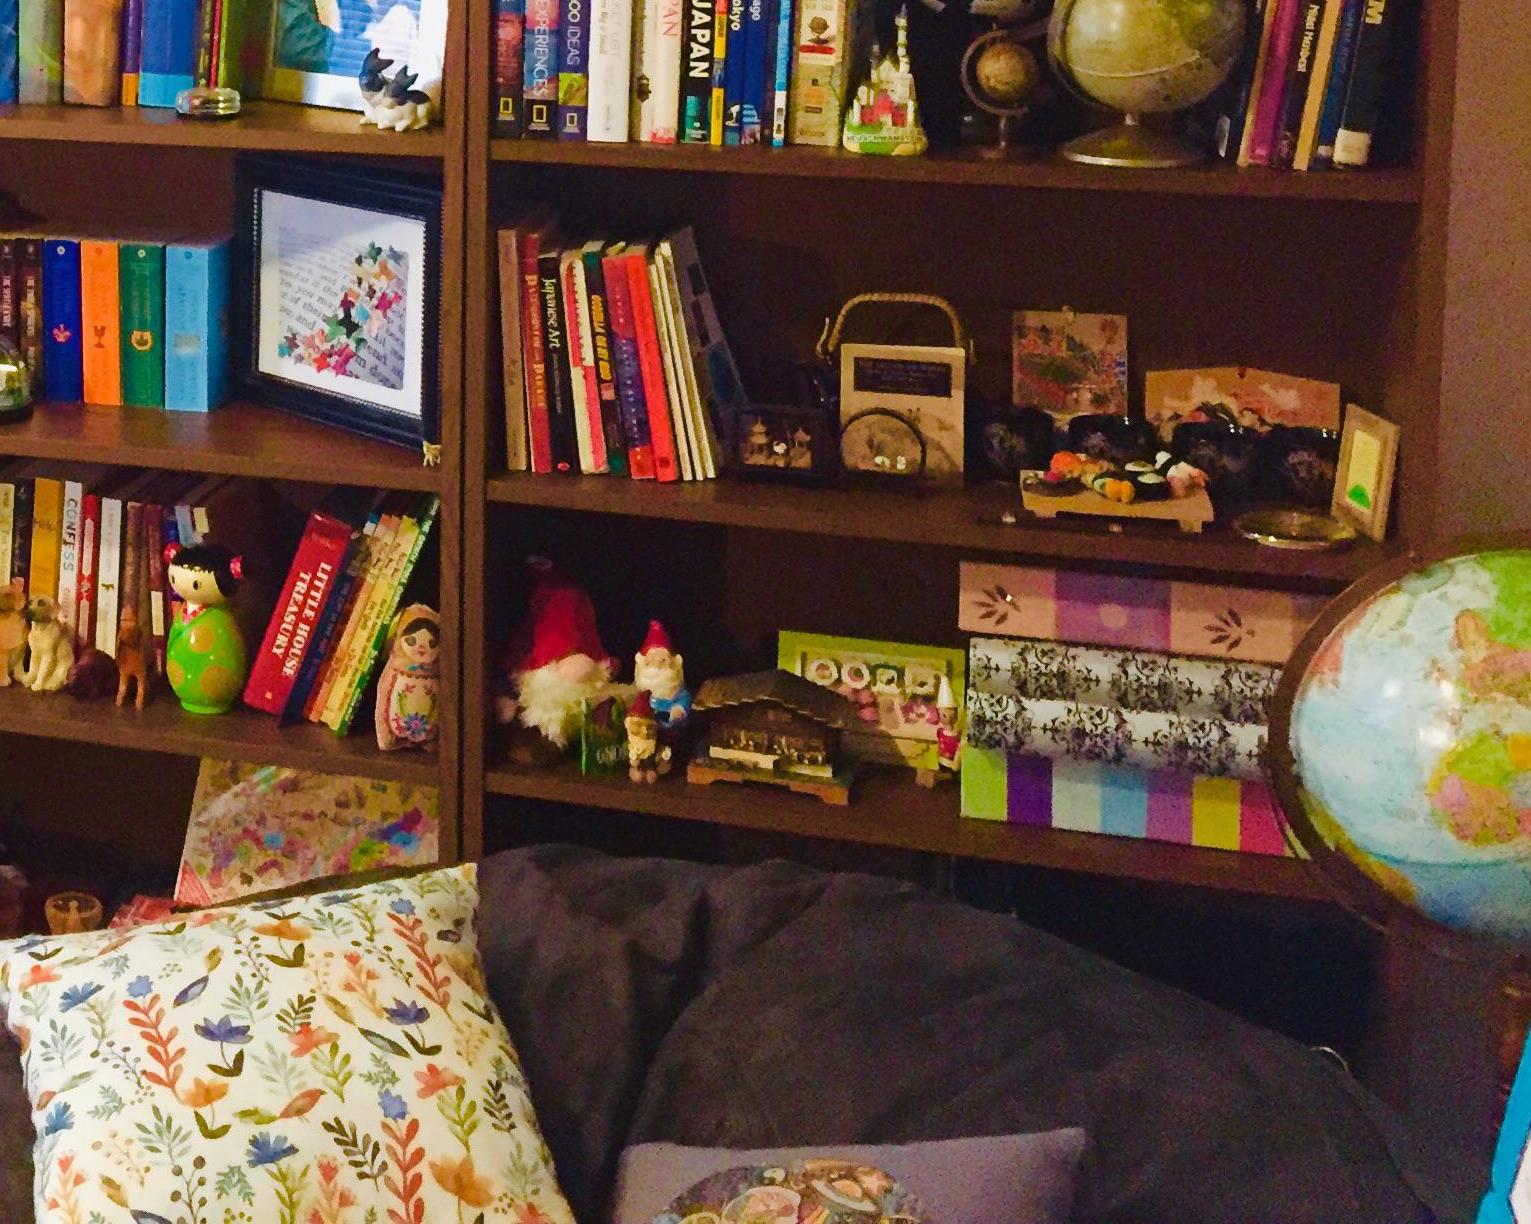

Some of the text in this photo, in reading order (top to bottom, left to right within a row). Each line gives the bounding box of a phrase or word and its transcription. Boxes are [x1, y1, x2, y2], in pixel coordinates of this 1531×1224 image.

[566, 26, 579, 65] IDEAS
[611, 32, 620, 57] LIST
[541, 278, 560, 328] Japanese
[548, 328, 562, 349] Art
[62, 498, 77, 572] CONFESS
[270, 571, 312, 659] TREASURY
[281, 561, 331, 678] LITTLE HOUSE
